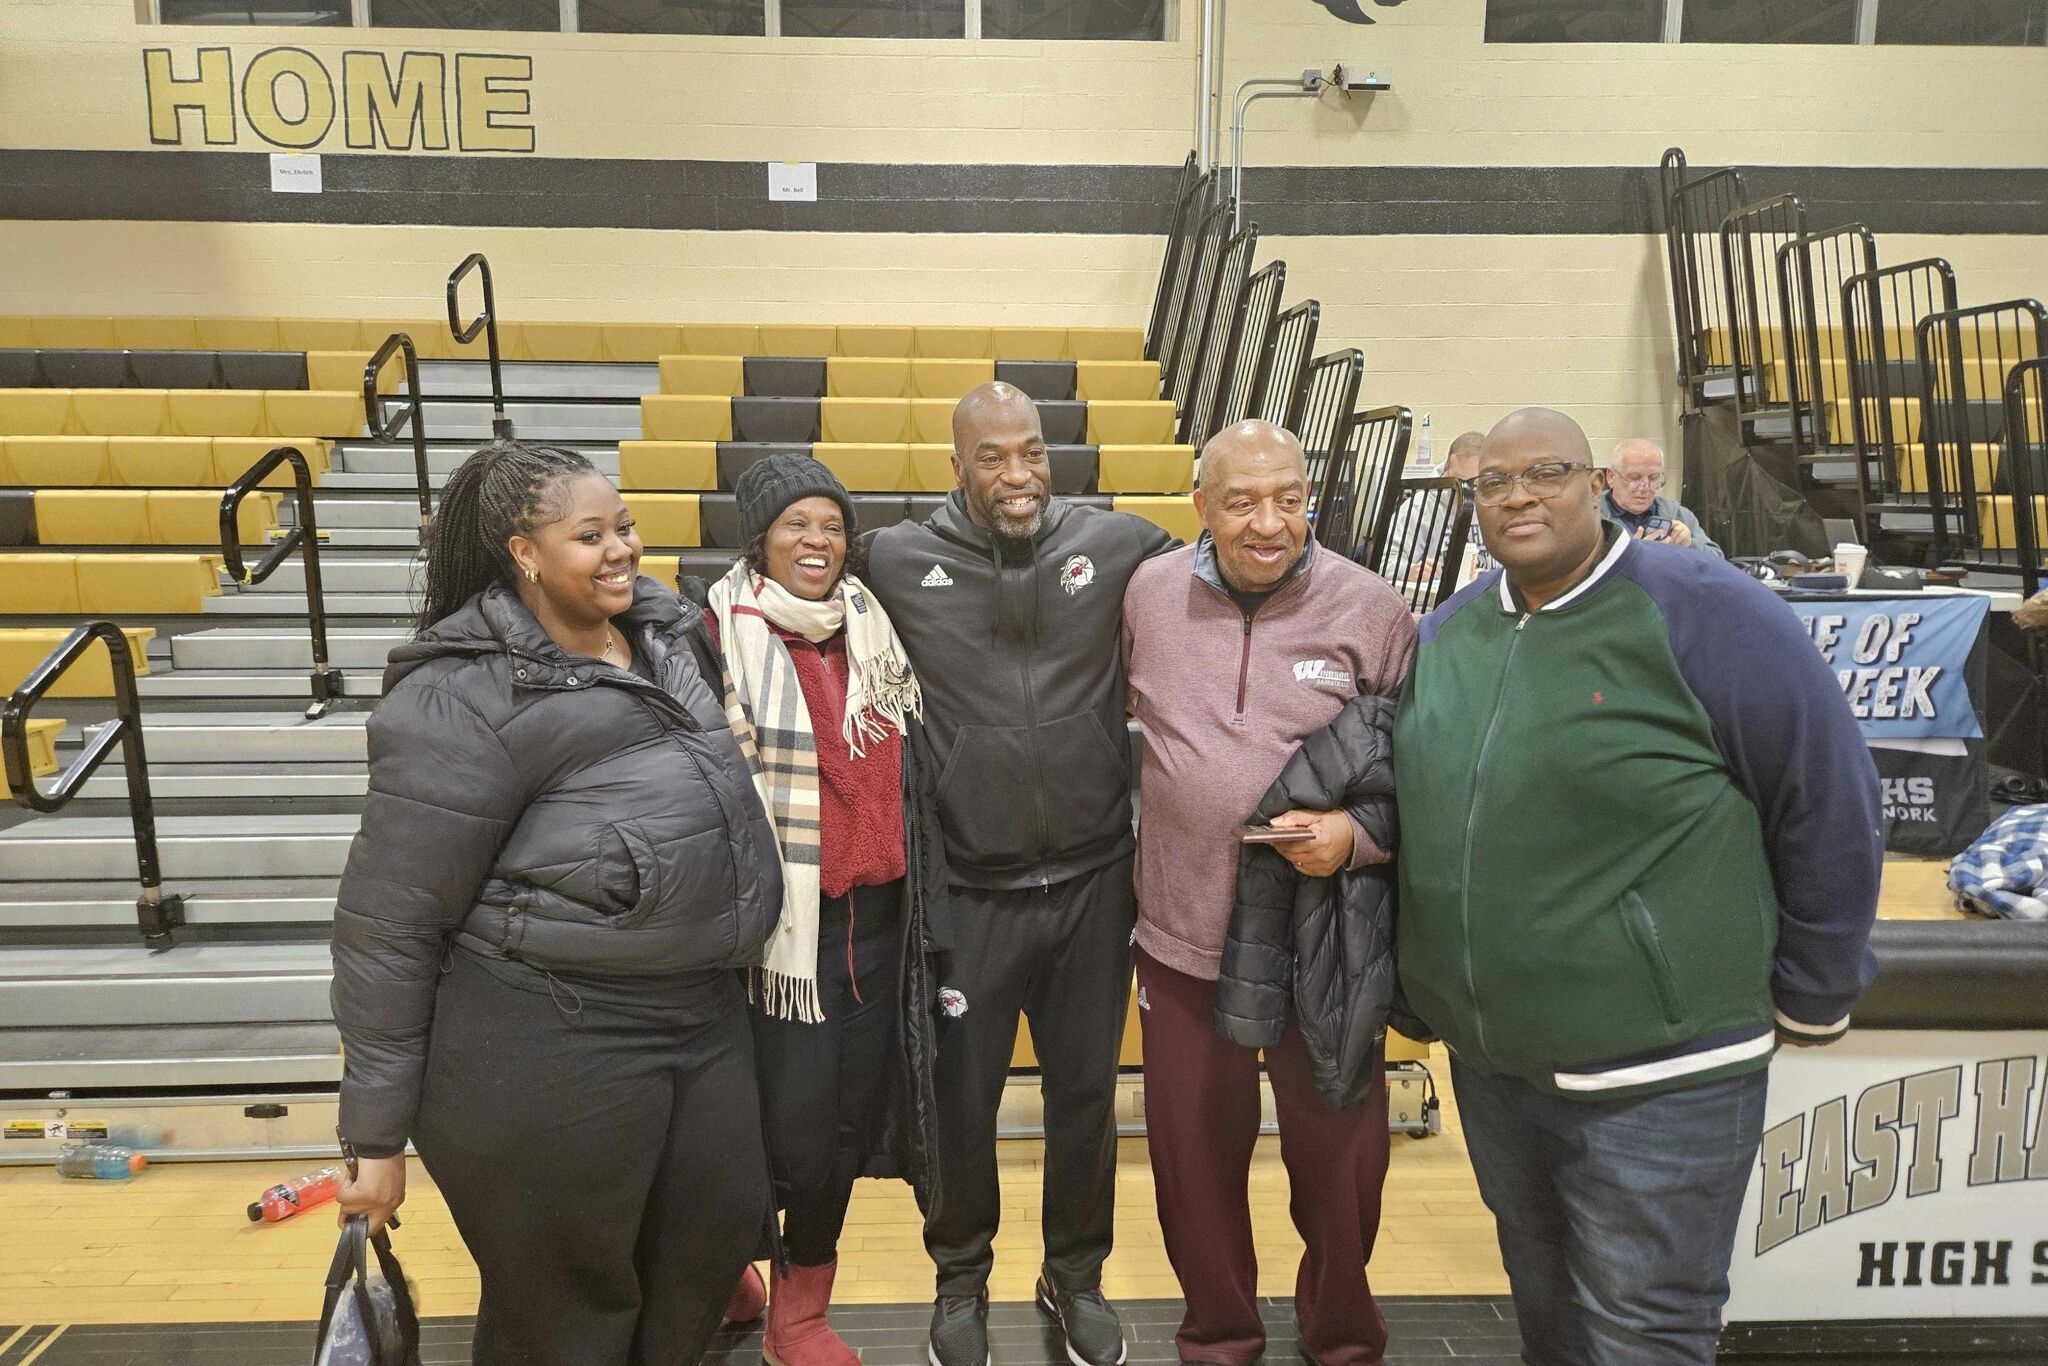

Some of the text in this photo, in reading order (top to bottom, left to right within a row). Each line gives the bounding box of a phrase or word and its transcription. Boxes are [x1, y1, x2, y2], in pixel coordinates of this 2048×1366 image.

[143, 47, 535, 152] HOME
[921, 578, 954, 586] adidas
[1852, 613, 1920, 664] OF
[1755, 1064, 1963, 1257] EAST
[1857, 1240, 2013, 1287] HIGH
